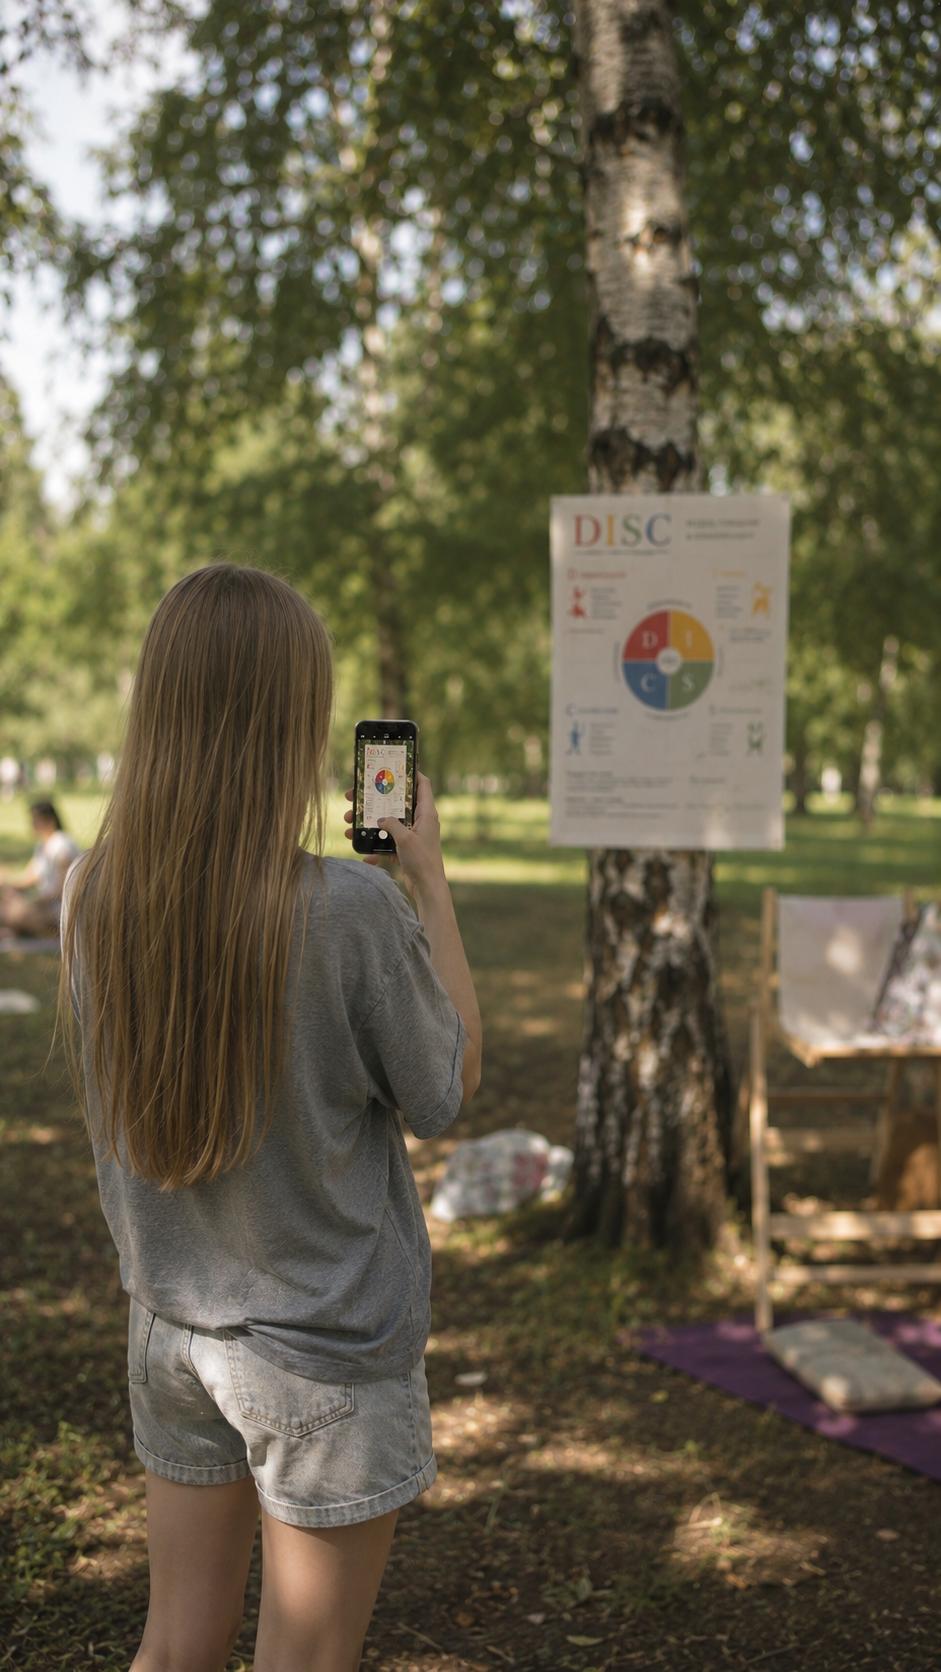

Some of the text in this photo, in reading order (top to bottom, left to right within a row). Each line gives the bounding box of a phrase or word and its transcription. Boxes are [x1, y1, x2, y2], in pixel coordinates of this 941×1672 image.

[574, 512, 672, 548] DISC
[641, 630, 658, 650] D
[640, 672, 658, 694] C
[681, 673, 696, 694] S
